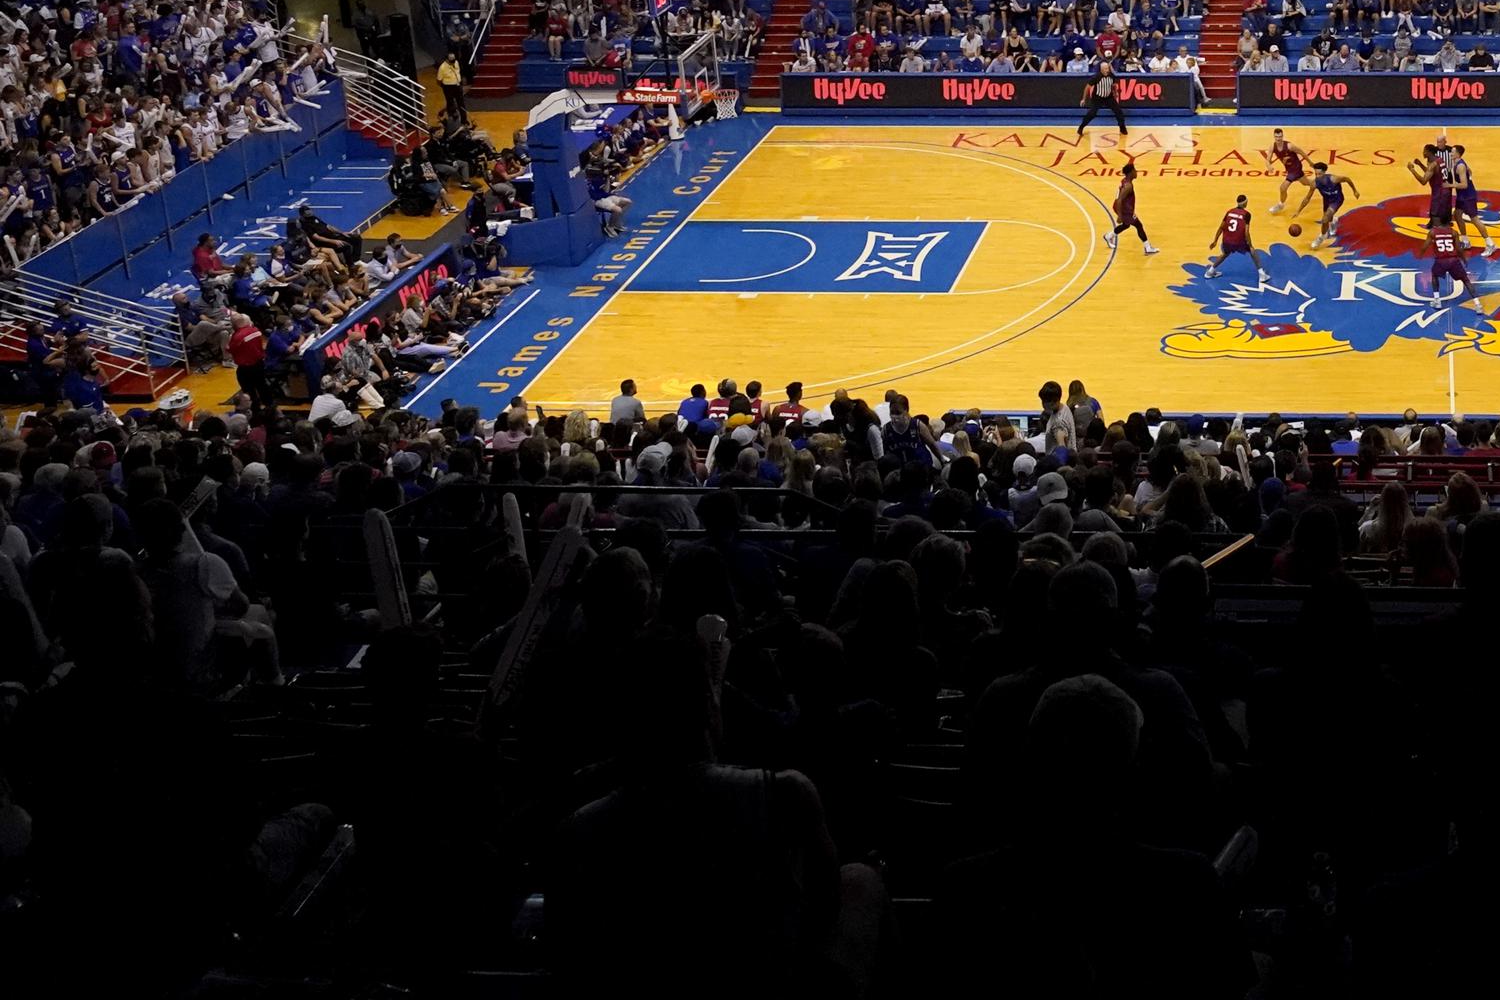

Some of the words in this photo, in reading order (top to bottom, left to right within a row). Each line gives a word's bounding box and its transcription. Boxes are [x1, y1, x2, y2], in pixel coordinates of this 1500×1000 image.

[813, 78, 886, 105] HyVee
[942, 78, 1015, 105] HyVee
[1116, 79, 1161, 101] Vee
[1274, 78, 1348, 105] HyVee
[1411, 78, 1485, 105] HyVee
[951, 132, 1200, 149] KANSAS
[1228, 218, 1239, 232] 3
[1435, 239, 1455, 253] 55
[477, 315, 575, 394] James
[568, 209, 680, 298] Naismith
[672, 150, 738, 196] Court
[1332, 271, 1465, 307] KU
